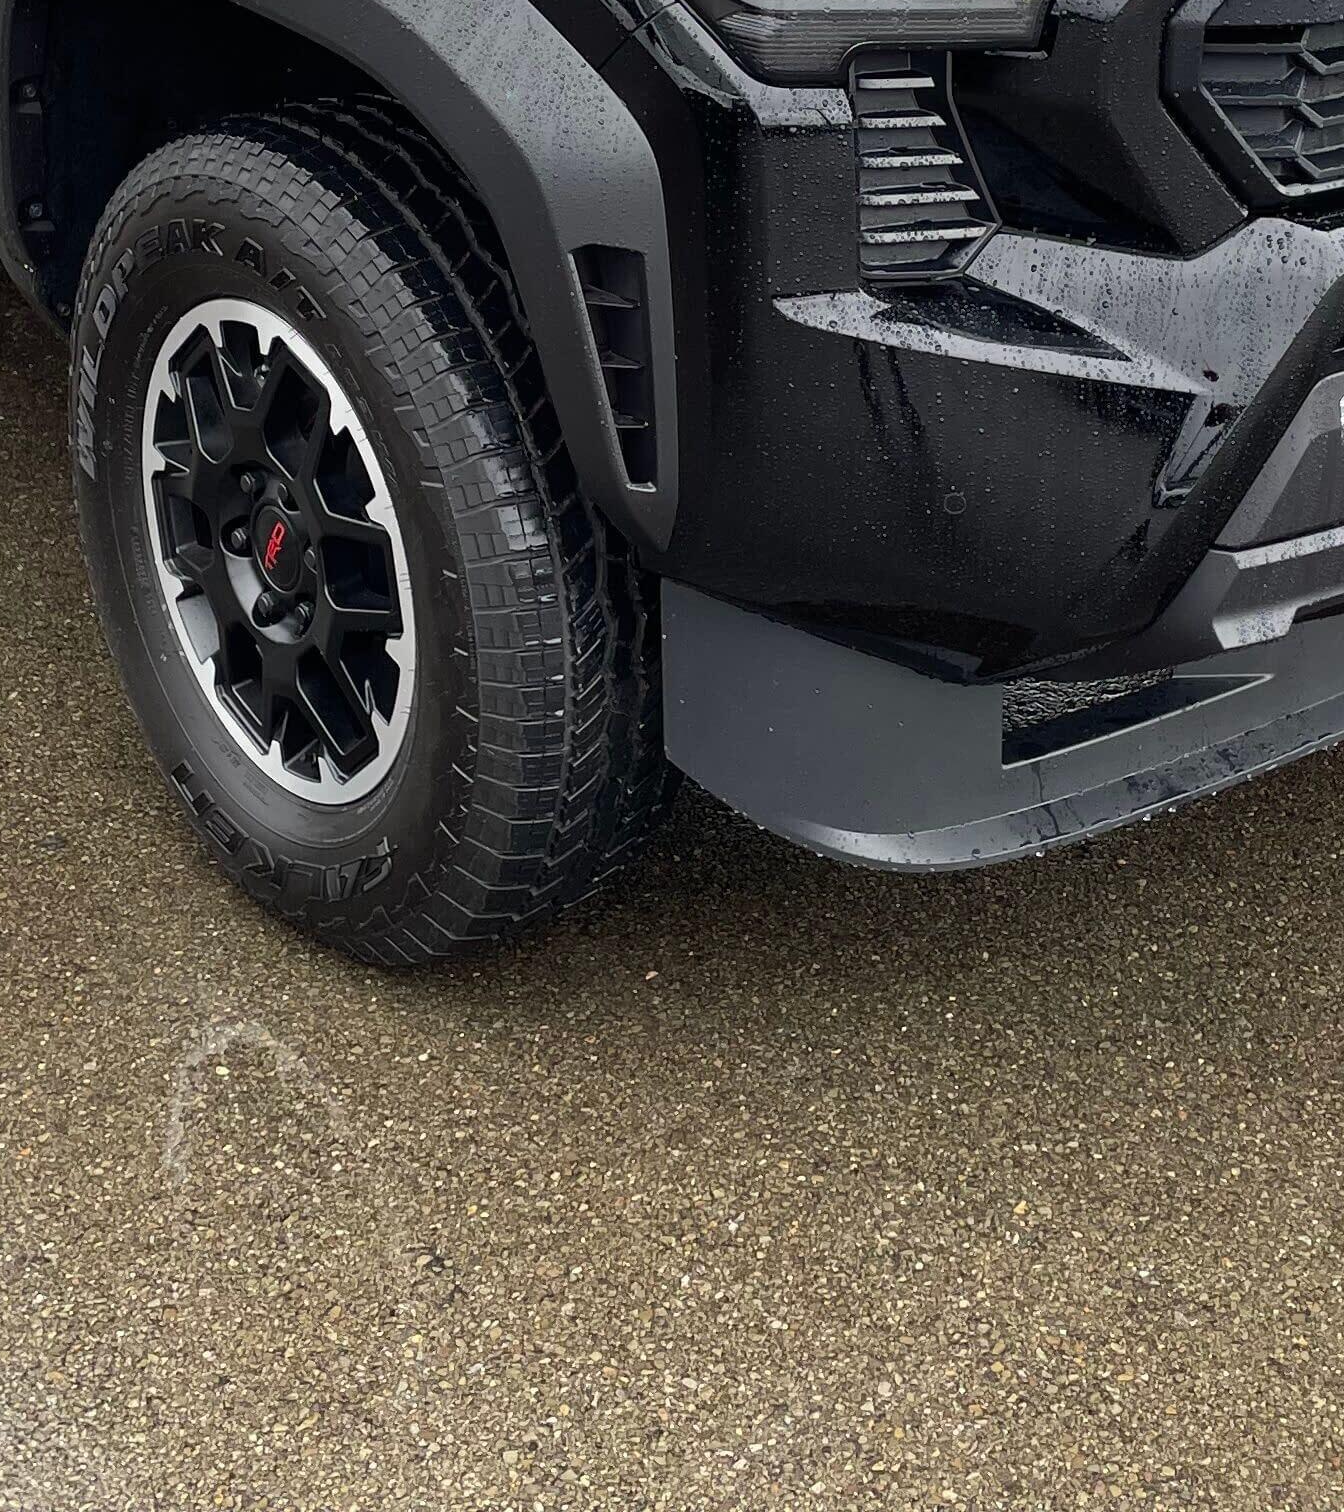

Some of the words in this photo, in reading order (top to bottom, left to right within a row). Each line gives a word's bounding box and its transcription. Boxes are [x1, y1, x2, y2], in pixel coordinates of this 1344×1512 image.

[76, 216, 226, 481] WILDPEAK
[264, 522, 286, 570] TRD
[169, 759, 399, 904] FALKEN
